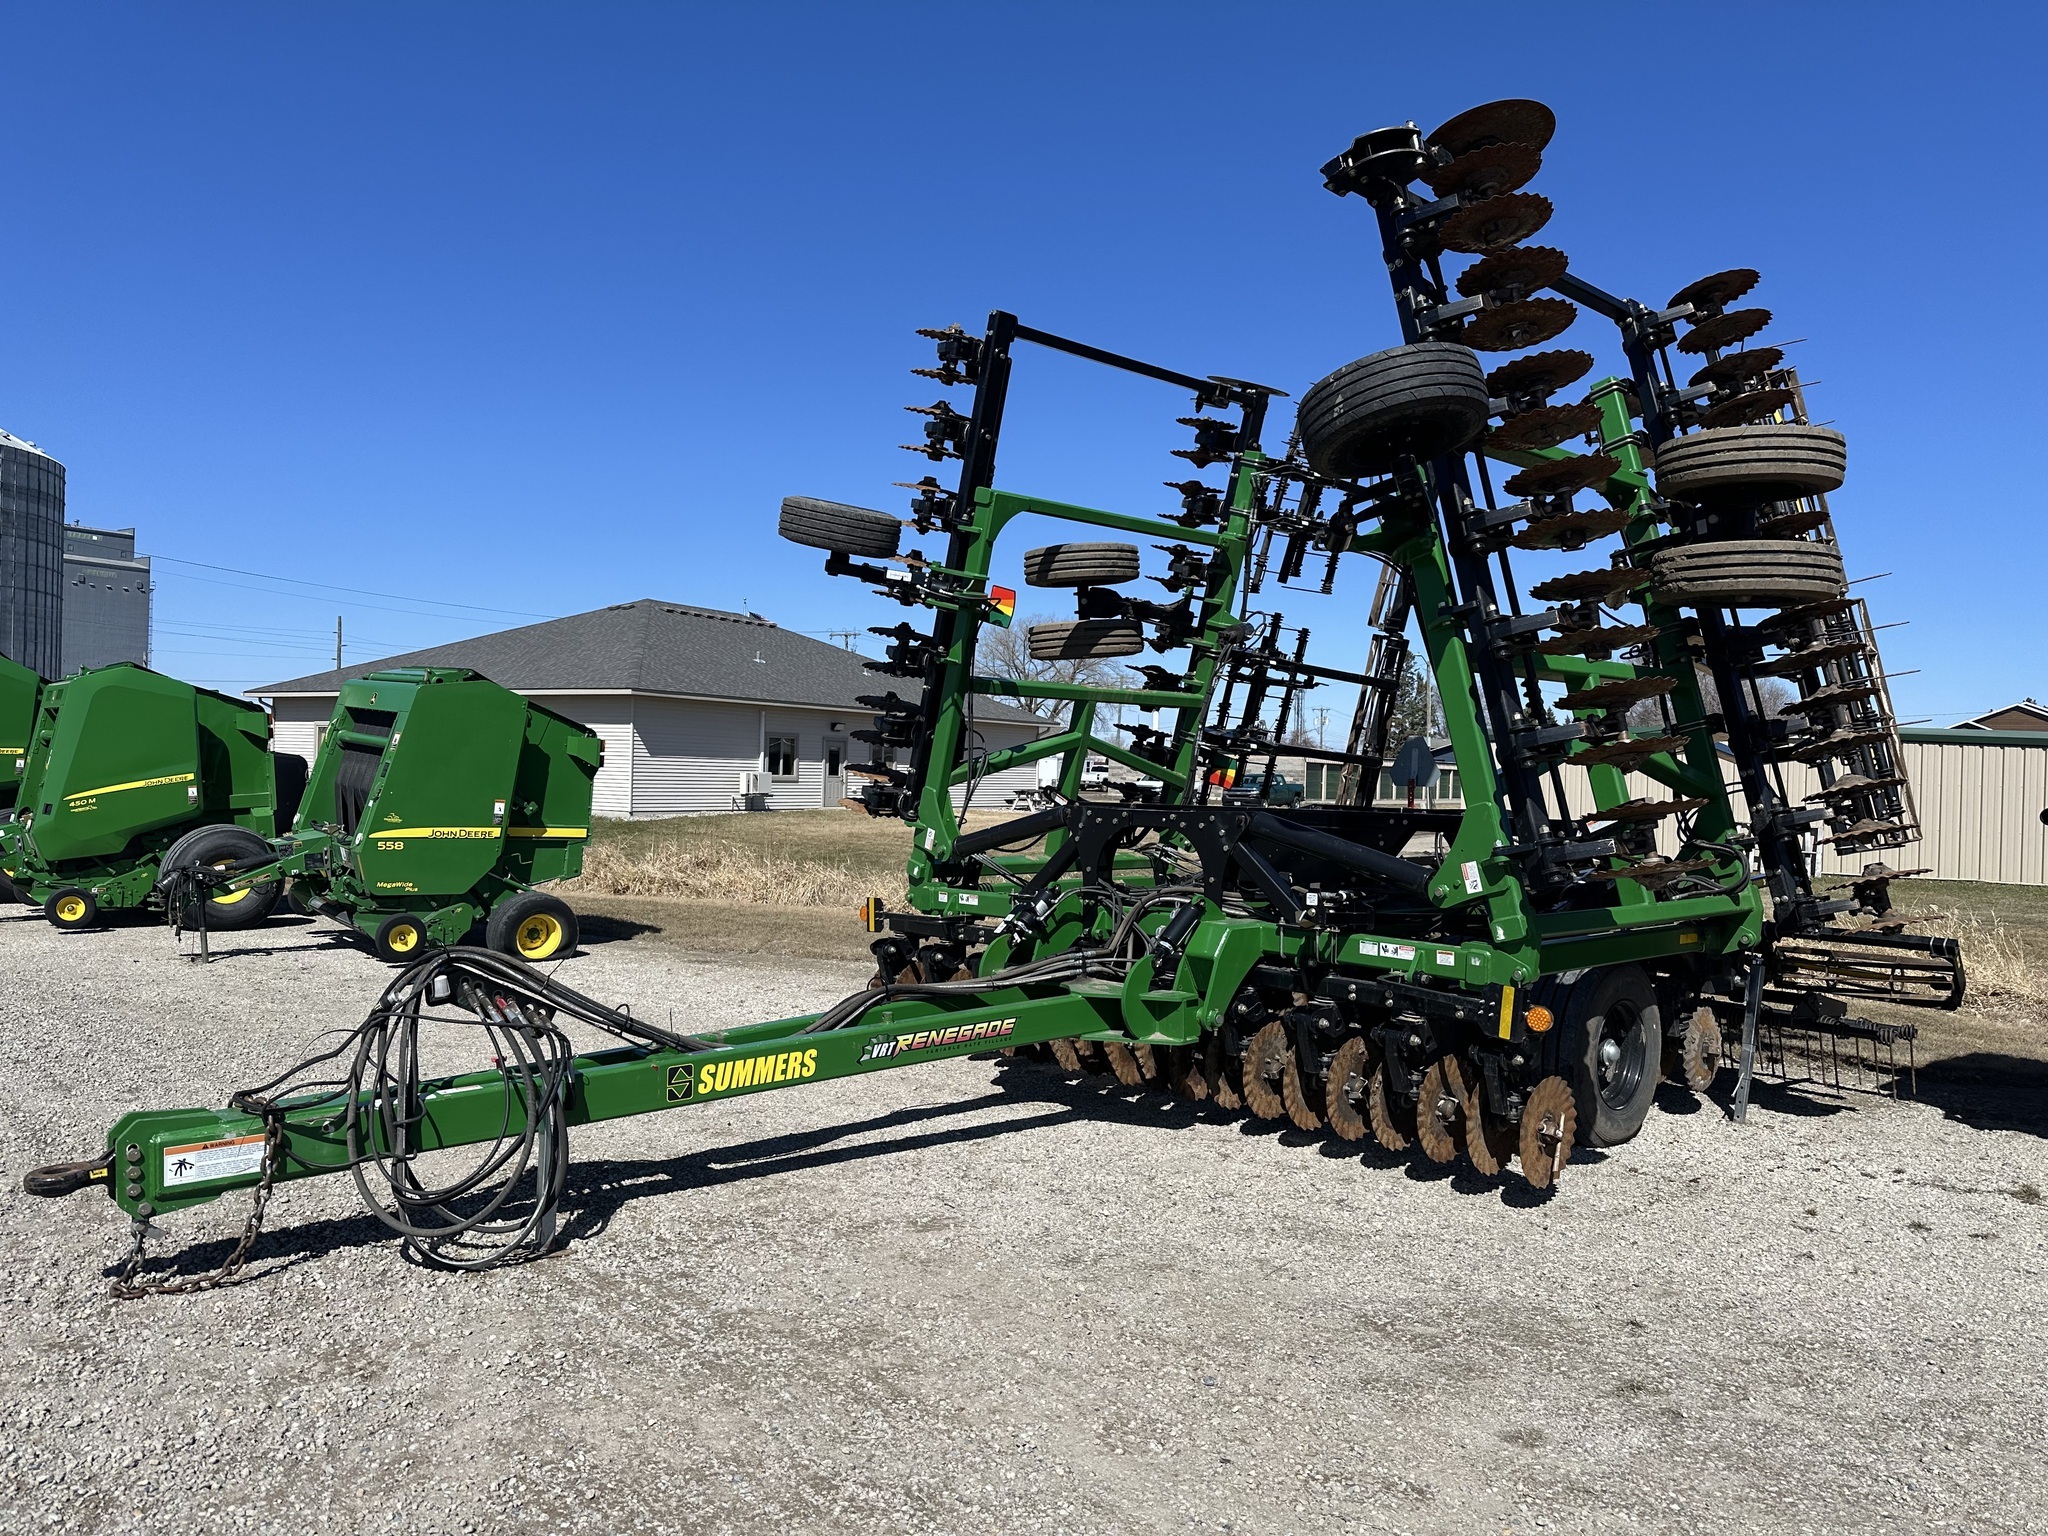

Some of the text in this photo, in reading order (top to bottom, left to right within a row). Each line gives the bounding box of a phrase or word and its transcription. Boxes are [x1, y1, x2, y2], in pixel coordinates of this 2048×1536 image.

[143, 775, 189, 787] JOHN DEERE
[69, 799, 87, 807] 450
[428, 829, 494, 838] JOHN DEERE
[377, 841, 404, 851] 558
[376, 881, 413, 889] MegaWide
[871, 1017, 1017, 1059] VRT RENEGADE
[926, 1045, 961, 1055] VARIABLE
[984, 1036, 1012, 1045] TILLAGE
[697, 1048, 818, 1095] SUMMERS
[209, 1140, 235, 1149] WARNING
